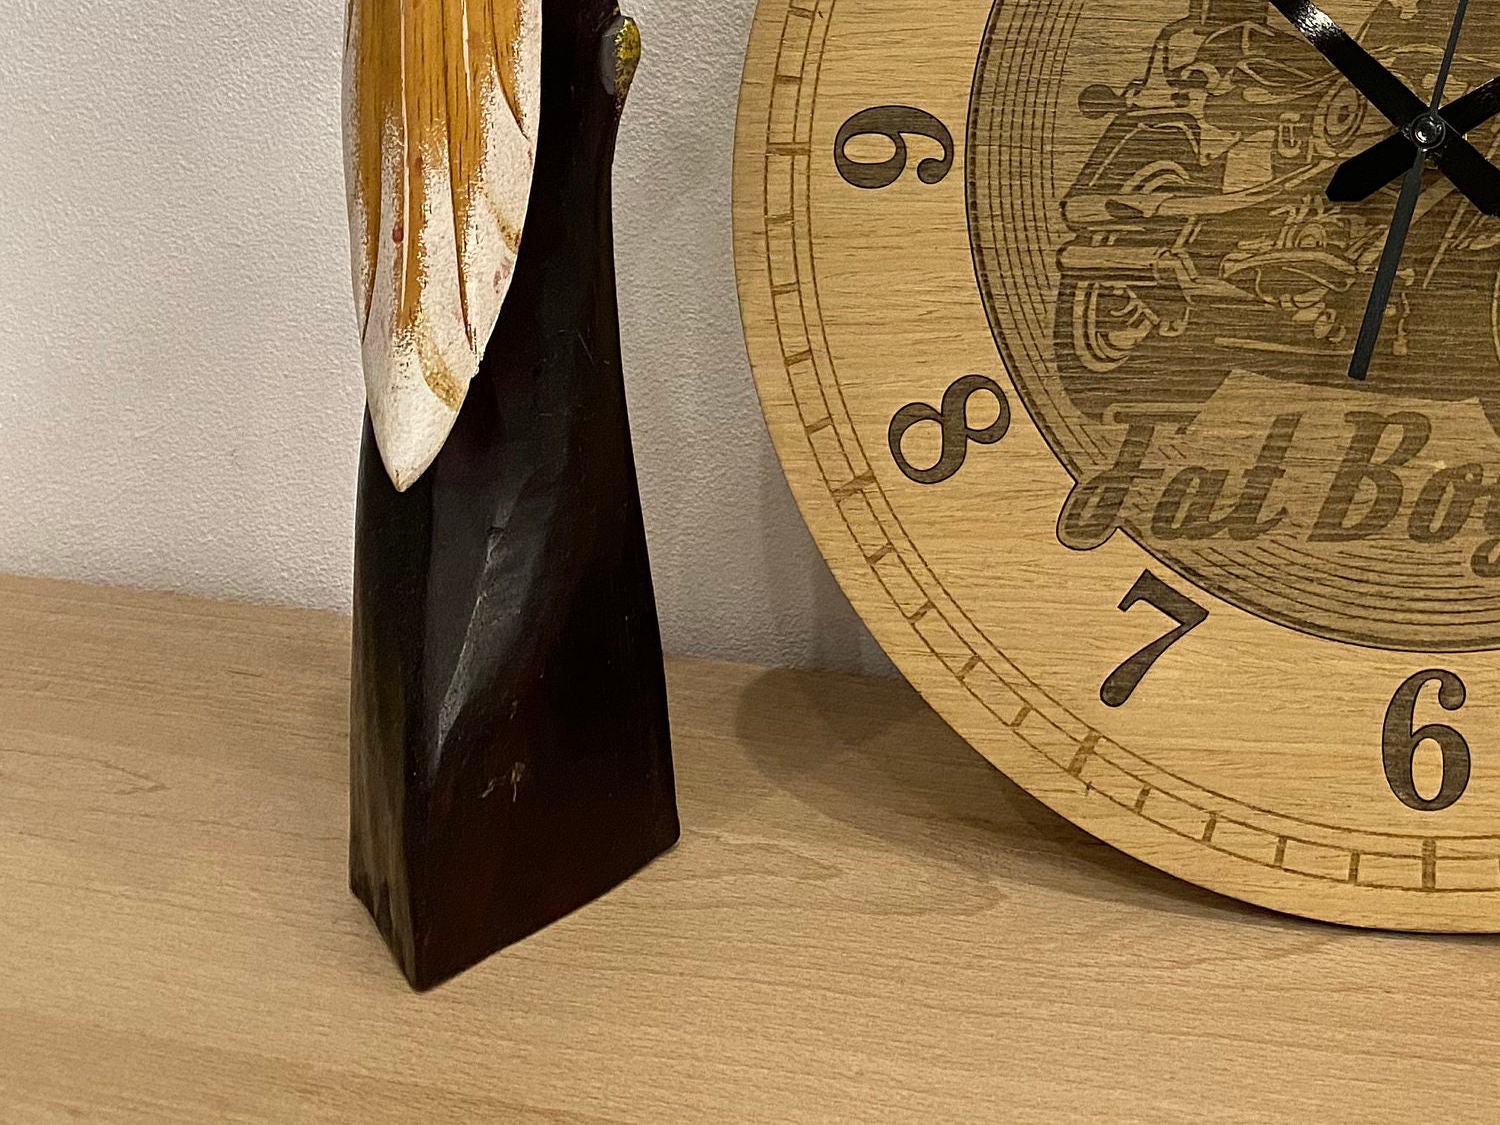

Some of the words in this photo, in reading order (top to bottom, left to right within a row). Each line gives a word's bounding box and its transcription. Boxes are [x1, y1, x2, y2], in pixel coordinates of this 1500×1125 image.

[833, 104, 955, 190] 9
[887, 373, 1012, 485] 8
[1063, 410, 1302, 543] Fat
[1099, 569, 1211, 708] 7
[1381, 668, 1472, 812] 6
